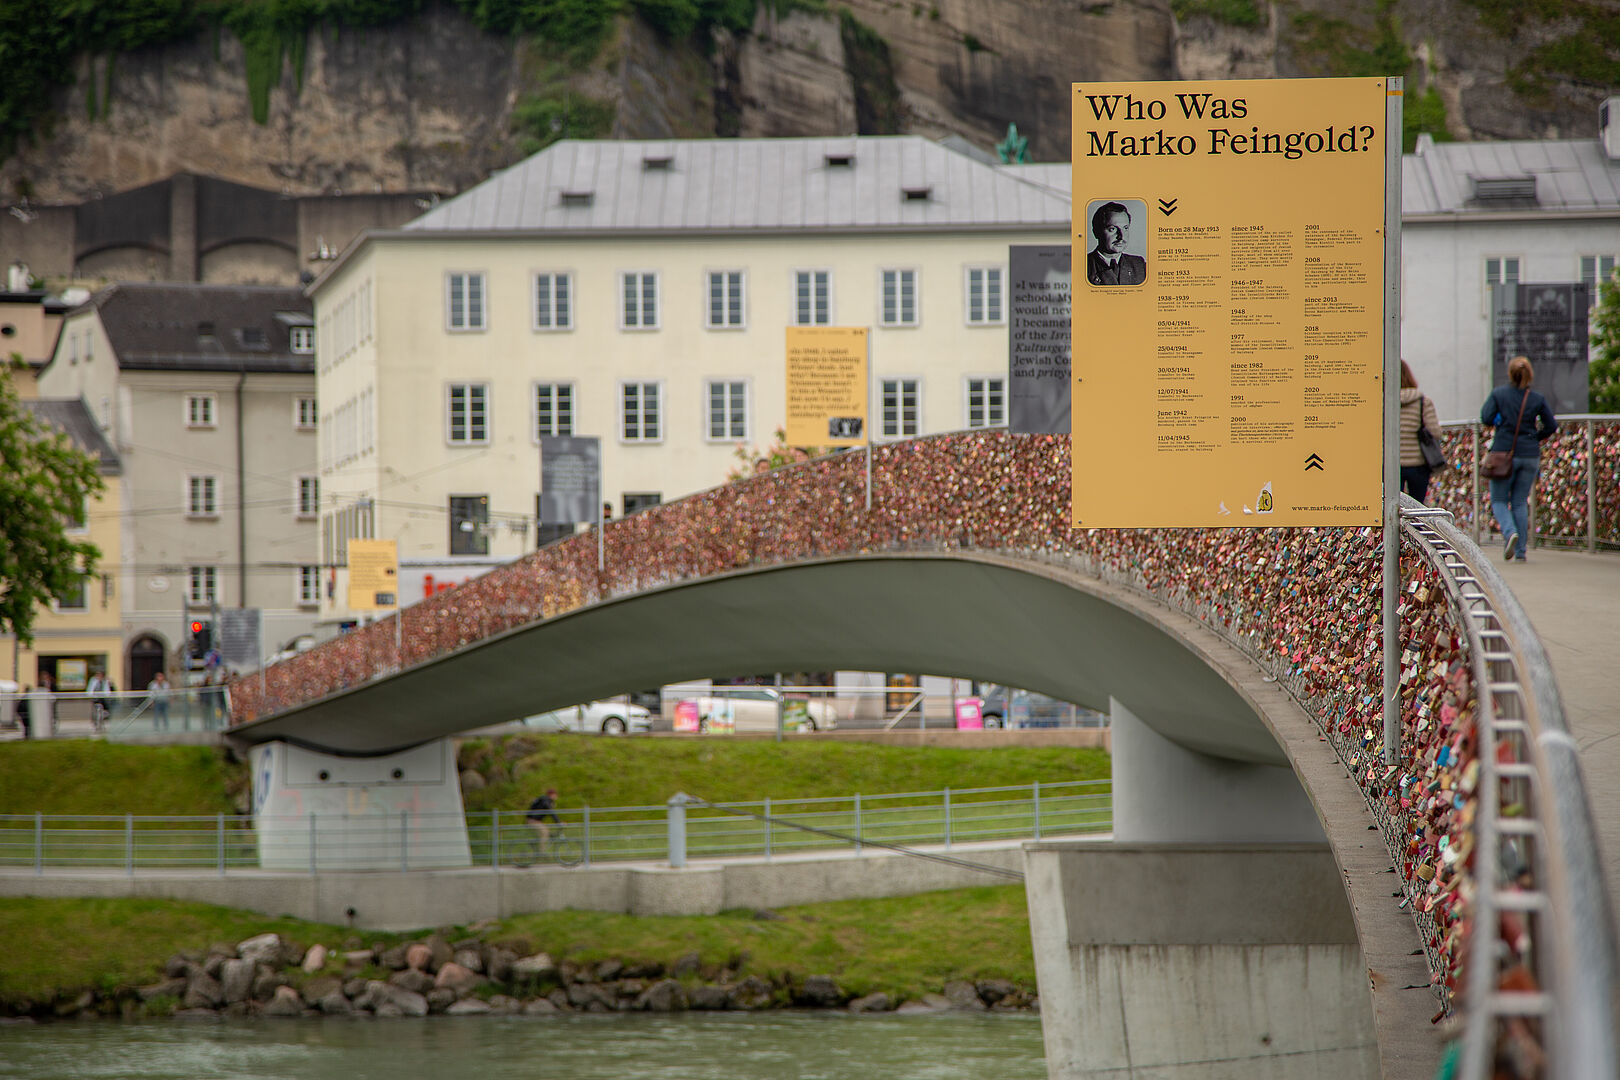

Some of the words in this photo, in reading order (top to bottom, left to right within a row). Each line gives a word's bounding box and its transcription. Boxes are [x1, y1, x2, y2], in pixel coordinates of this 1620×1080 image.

[1085, 94, 1166, 121] Who
[1175, 94, 1248, 120] Was
[1086, 130, 1196, 157] Marko
[1208, 125, 1374, 160] Feingold?
[1016, 306, 1048, 314] would
[1023, 318, 1065, 327] became
[1015, 331, 1026, 339] of
[1029, 331, 1047, 339] the
[1014, 355, 1051, 366] Jewish
[1055, 355, 1071, 365] Co
[1014, 368, 1034, 377] and
